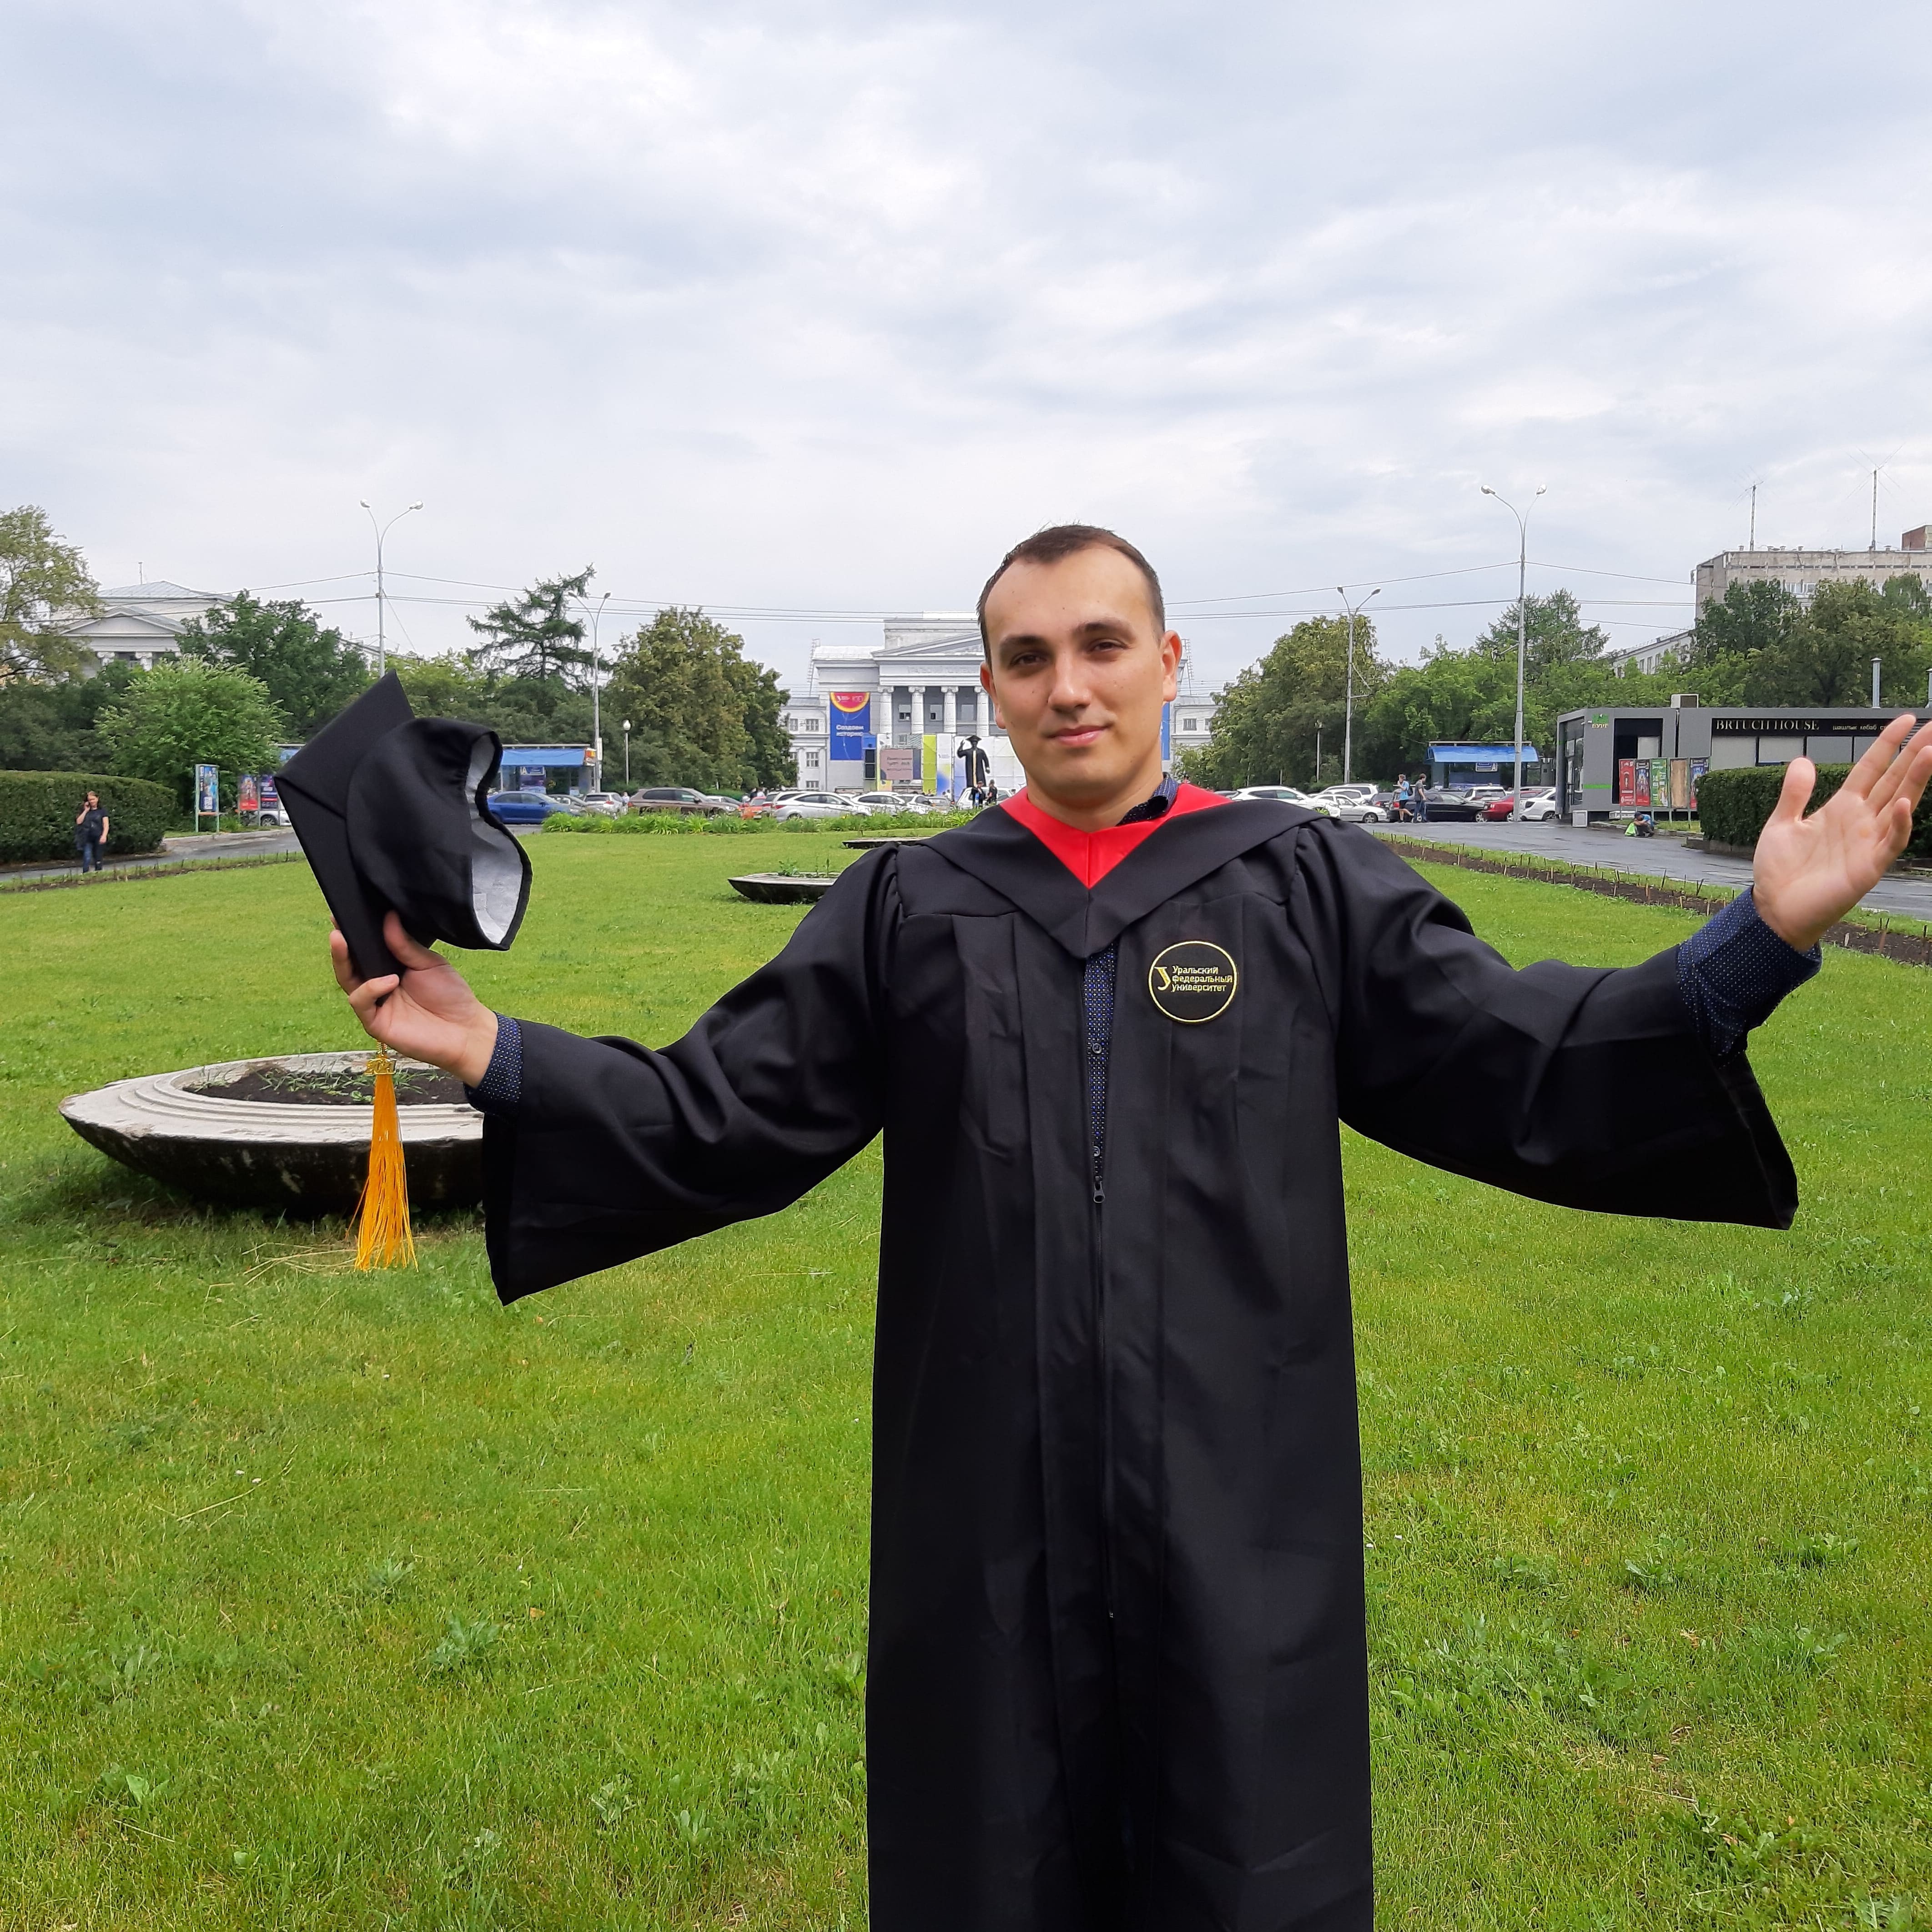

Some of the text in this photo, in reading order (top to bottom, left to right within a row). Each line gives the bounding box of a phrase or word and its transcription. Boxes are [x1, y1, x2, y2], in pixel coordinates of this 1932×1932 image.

[1774, 719, 1819, 730] HOUSE
[1172, 966, 1219, 975] Уральский
[1172, 975, 1233, 984] федеральный
[1171, 984, 1227, 992] университет
